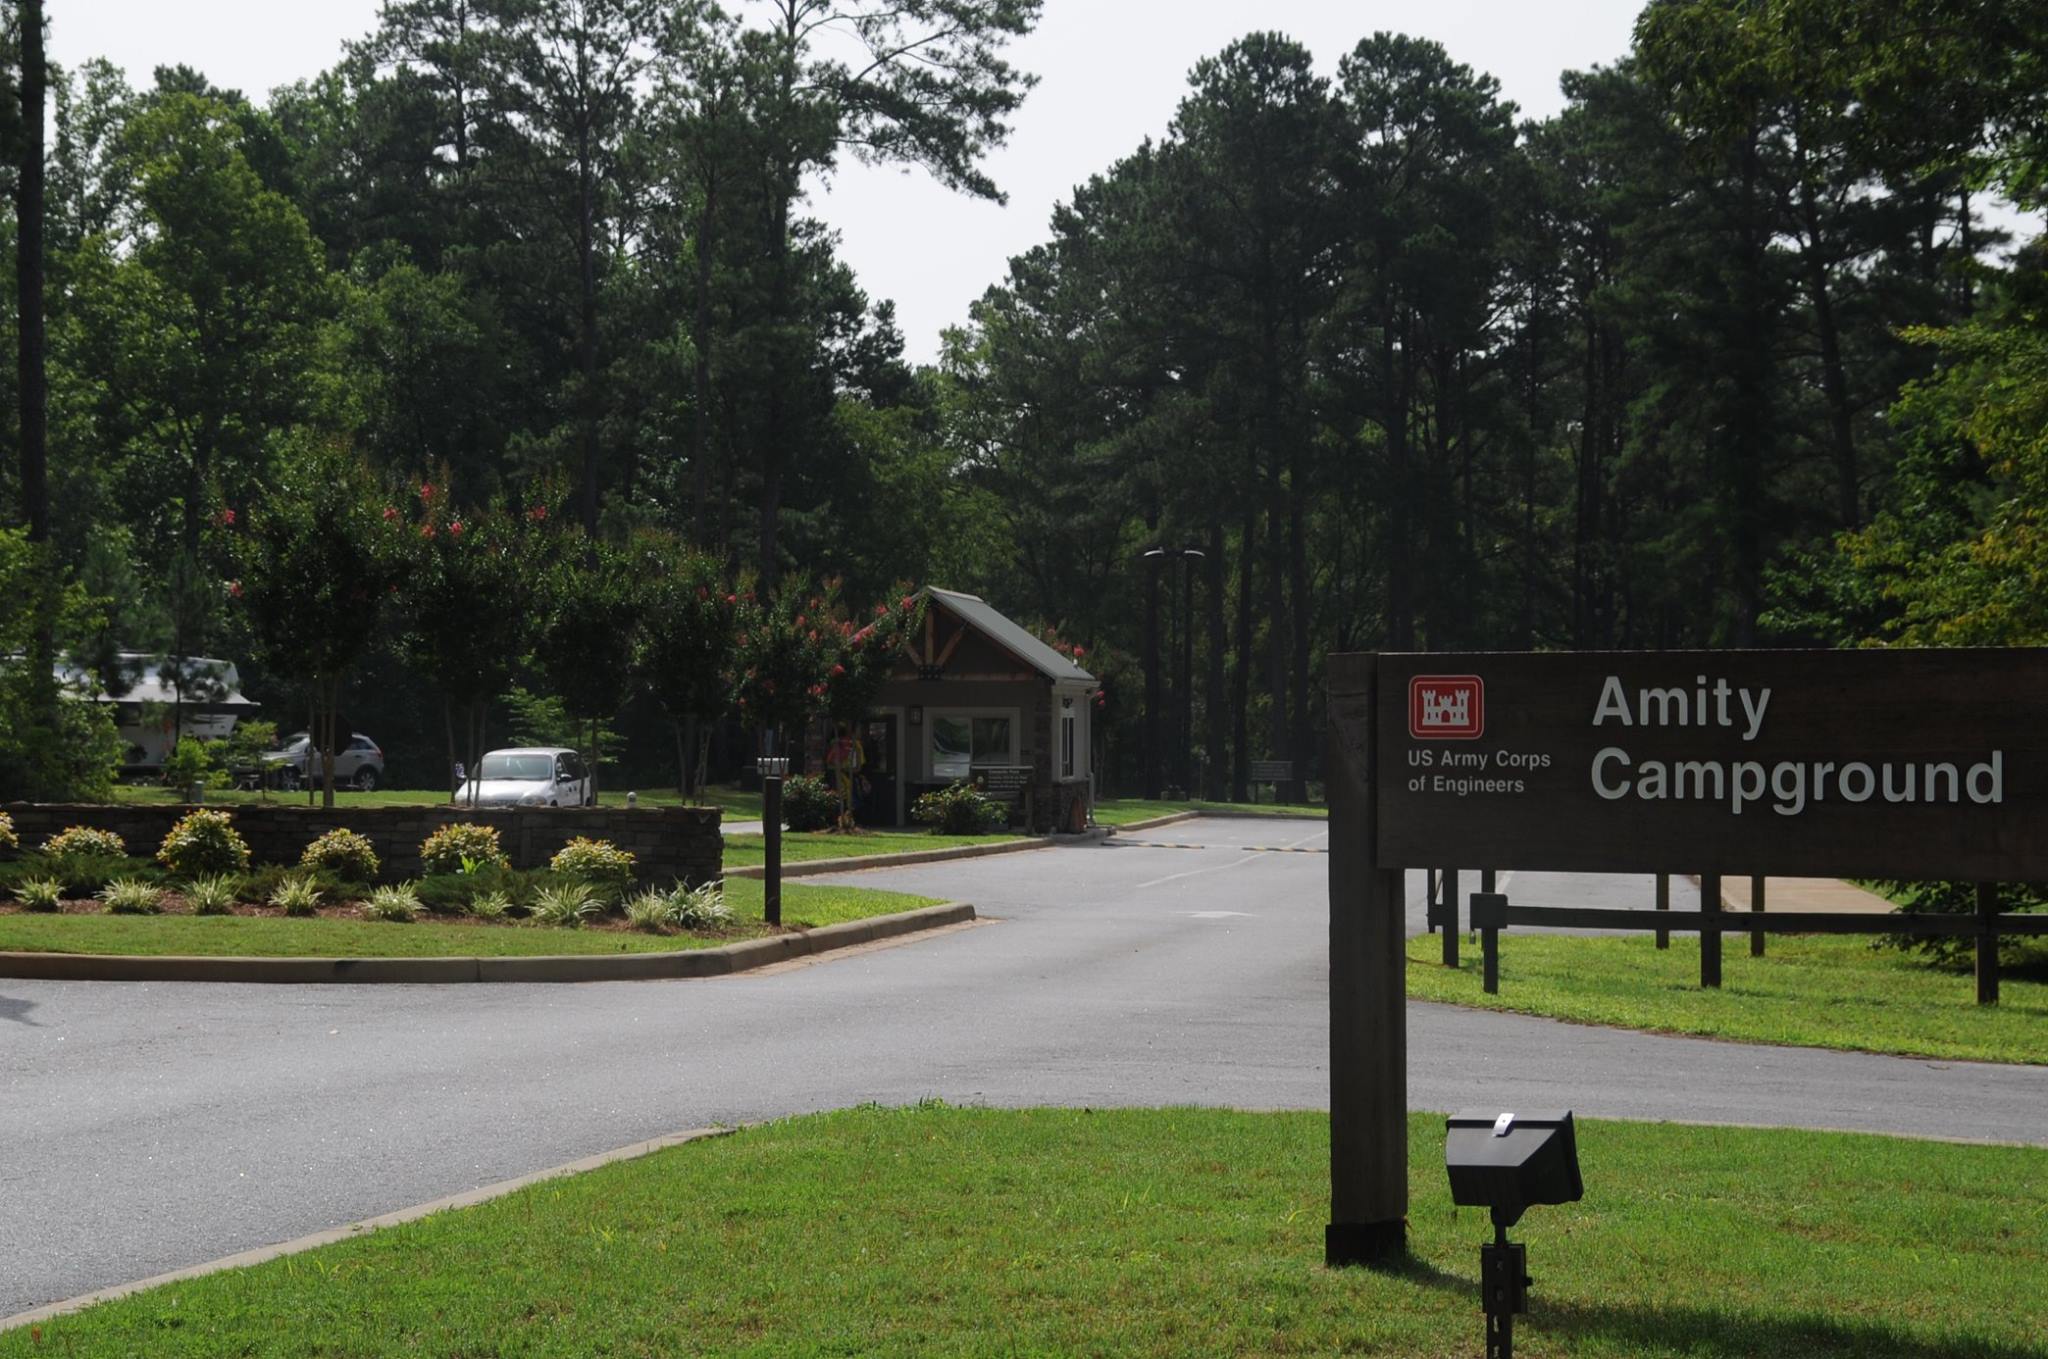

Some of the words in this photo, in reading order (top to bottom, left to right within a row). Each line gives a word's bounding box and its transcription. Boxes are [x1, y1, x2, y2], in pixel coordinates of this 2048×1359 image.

[1592, 675, 1772, 741] Amity
[1408, 749, 1433, 767] US
[1440, 750, 1488, 770] Army
[1496, 750, 1551, 771] Corps
[1591, 747, 2002, 816] Campground
[1408, 775, 1426, 792] of
[1433, 775, 1524, 797] Engineers
